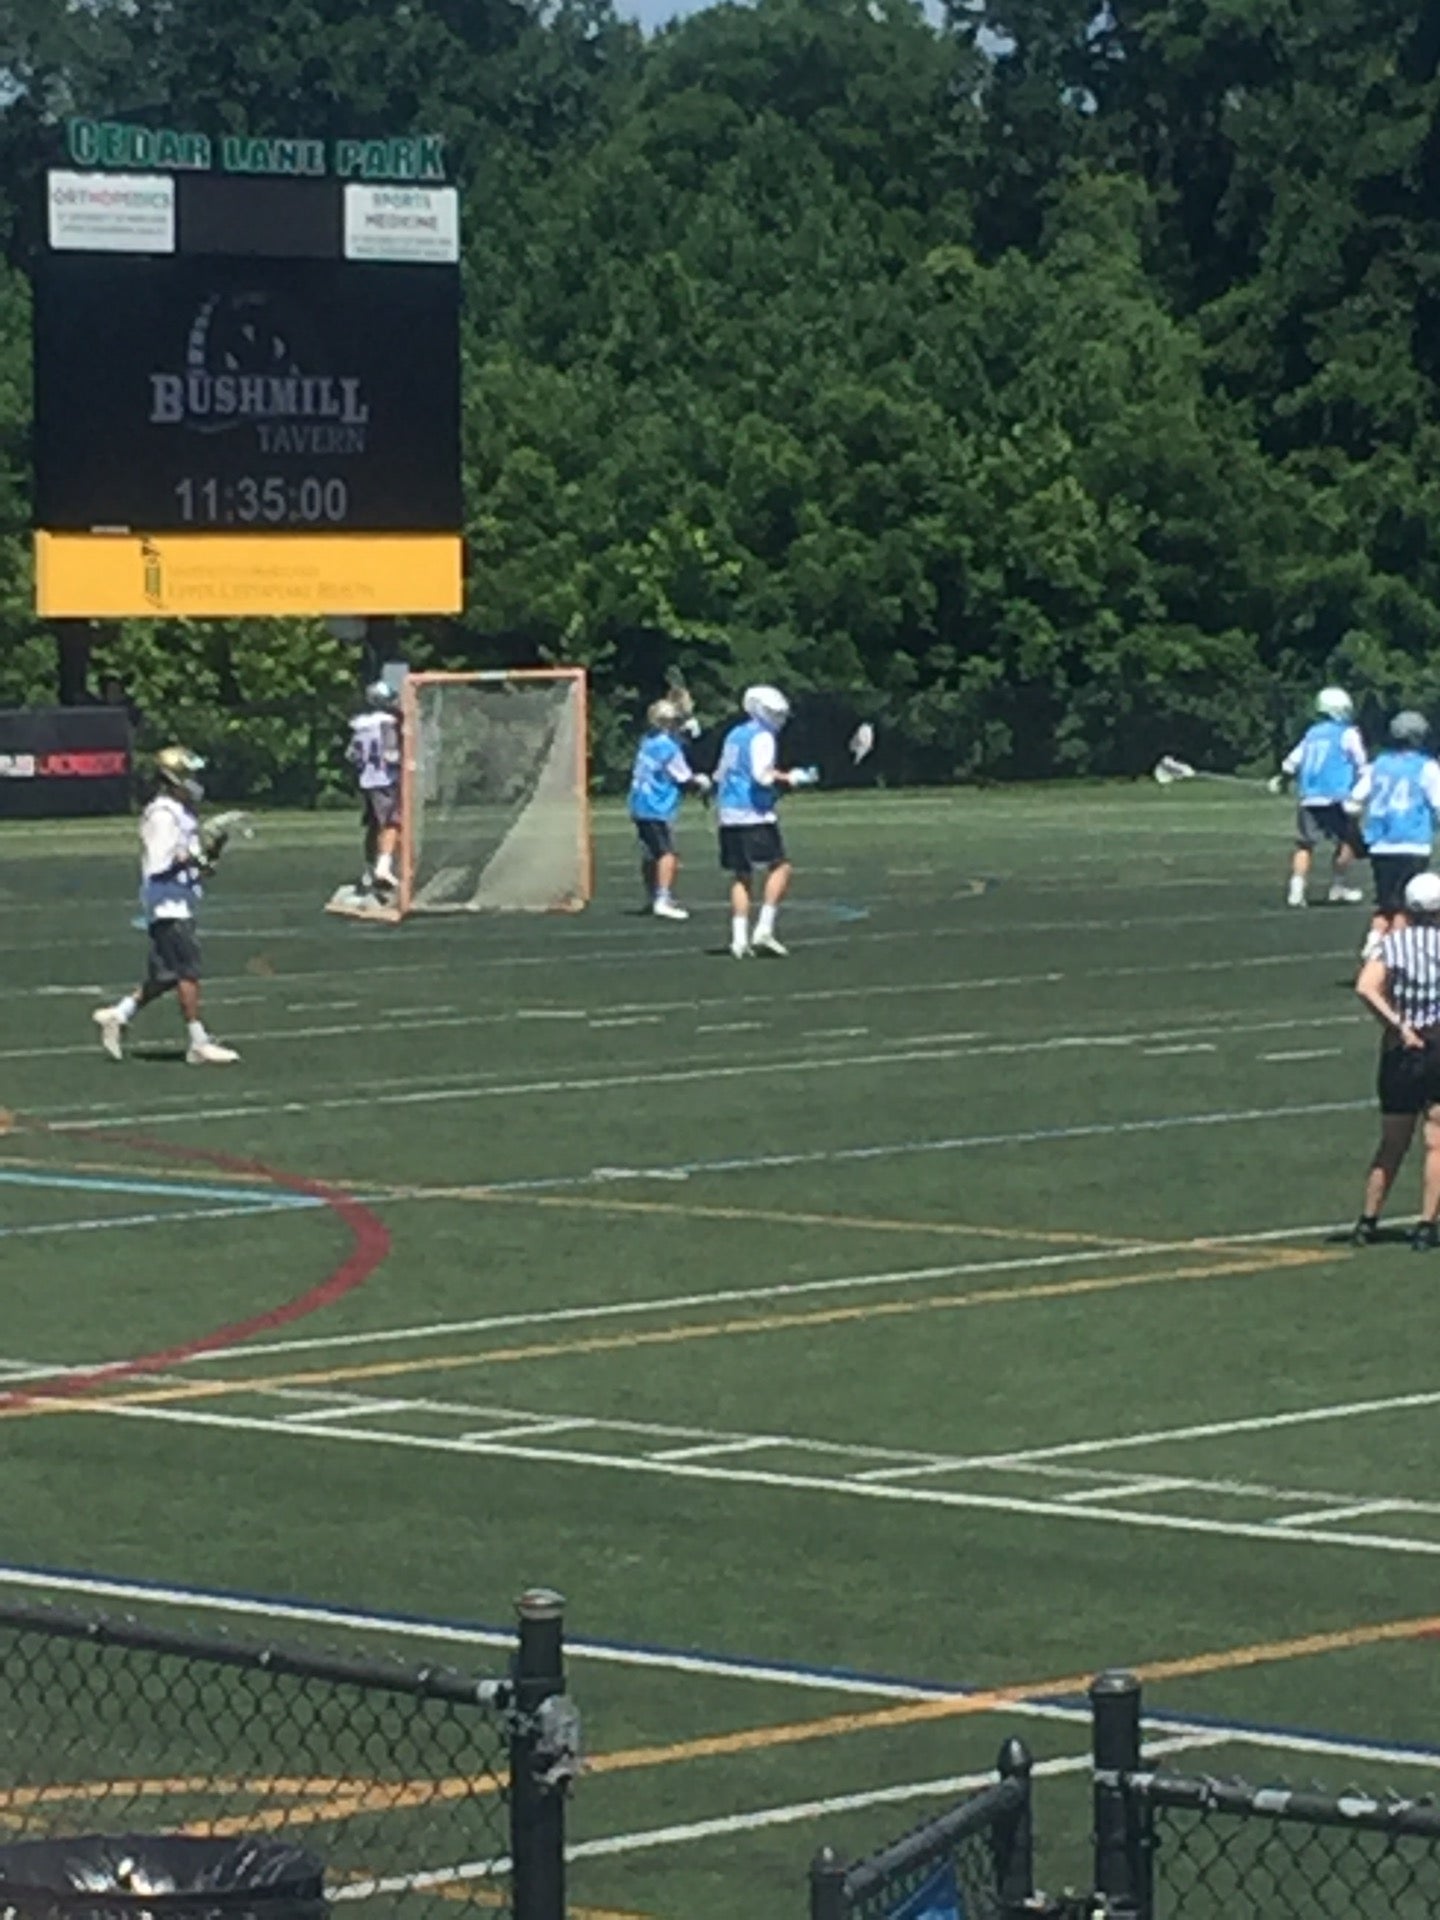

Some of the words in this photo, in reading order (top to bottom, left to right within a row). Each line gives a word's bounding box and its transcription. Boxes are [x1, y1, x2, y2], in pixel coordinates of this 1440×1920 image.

[69, 119, 210, 170] CEDAR
[223, 135, 325, 175] LANE
[337, 134, 445, 179] PARK
[364, 213, 439, 232] MEDICINE
[150, 374, 368, 423] BUSHMILL
[257, 425, 366, 453] TAVERN
[174, 477, 347, 521] 11:35:00
[1369, 775, 1410, 816] 24
